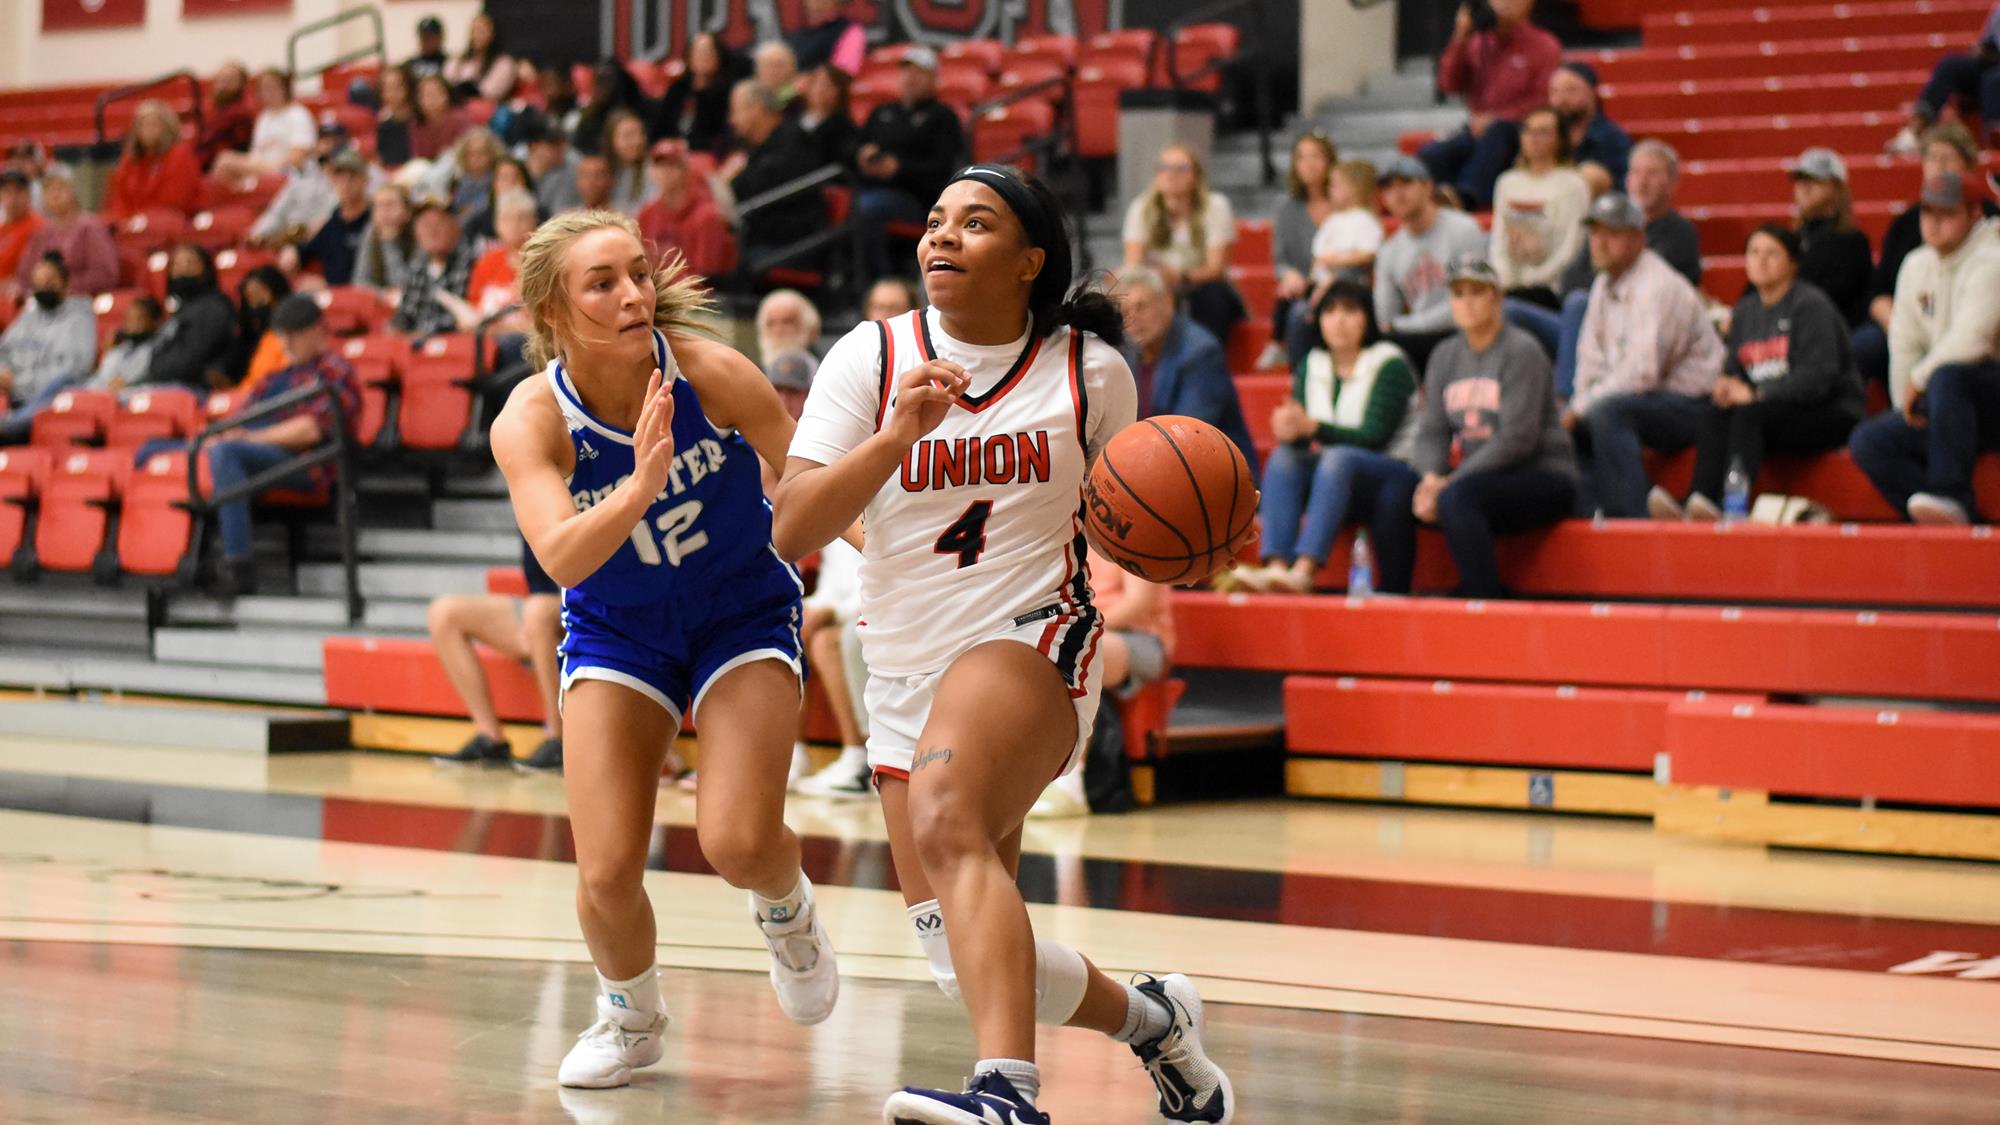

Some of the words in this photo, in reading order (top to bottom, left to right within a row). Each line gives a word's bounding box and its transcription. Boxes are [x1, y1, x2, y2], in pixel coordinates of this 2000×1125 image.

[573, 438, 727, 515] STER
[900, 430, 1050, 493] UNION
[630, 500, 709, 567] 12
[933, 500, 994, 569] 4
